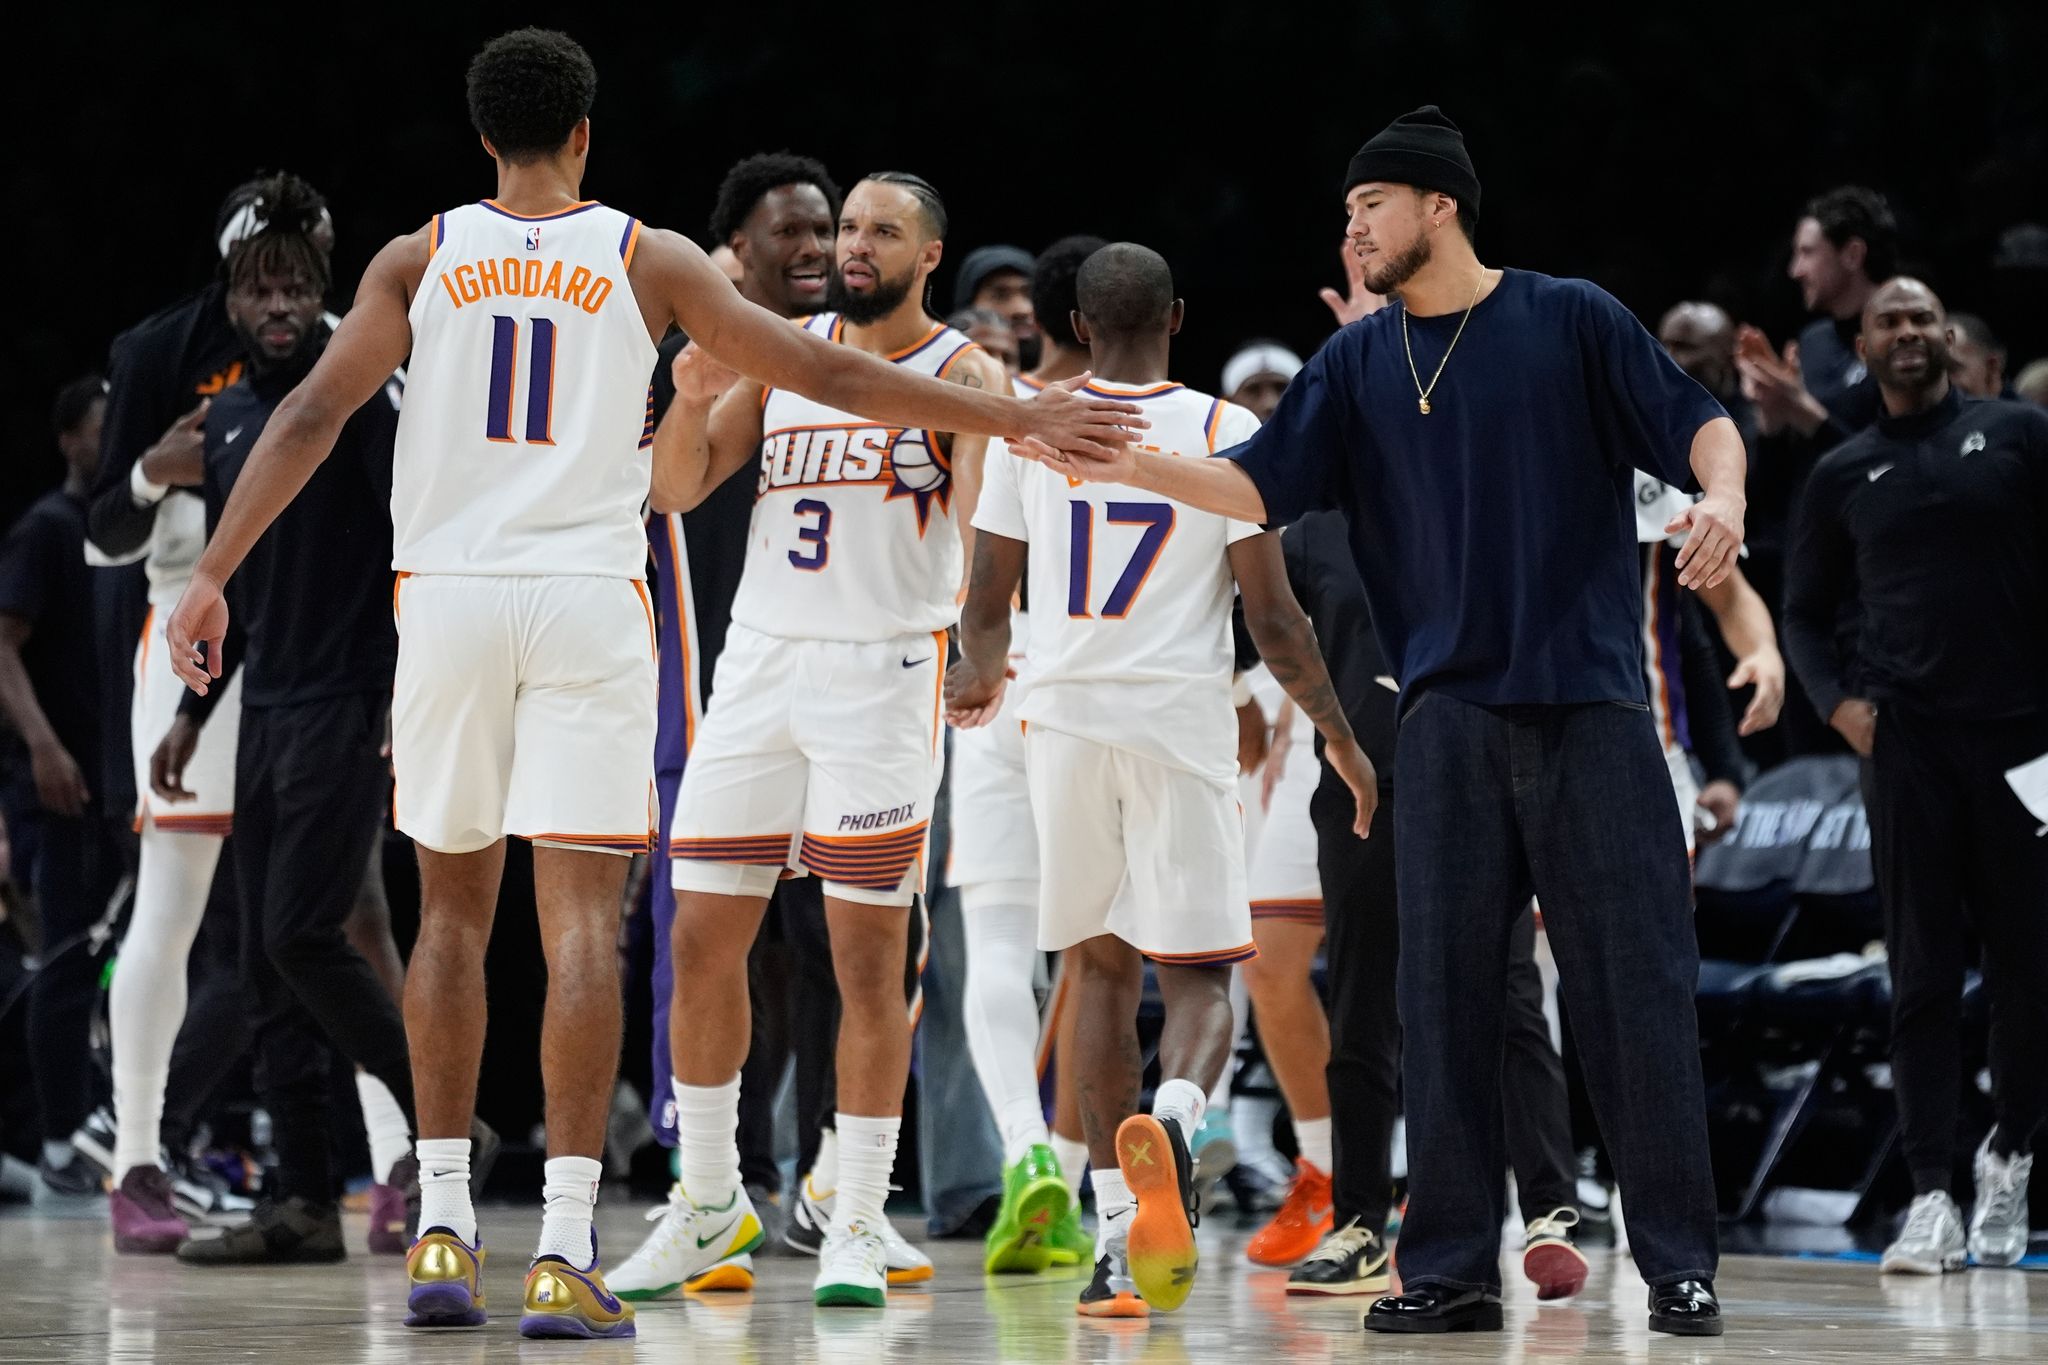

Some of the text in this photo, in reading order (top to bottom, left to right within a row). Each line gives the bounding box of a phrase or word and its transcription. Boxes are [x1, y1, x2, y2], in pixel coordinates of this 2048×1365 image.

[441, 257, 613, 315] IGHODARO
[486, 314, 557, 446] 11
[757, 428, 889, 497] SUNS
[788, 498, 833, 572] 3
[1068, 499, 1176, 620] 17
[838, 801, 917, 831] PHOENIX
